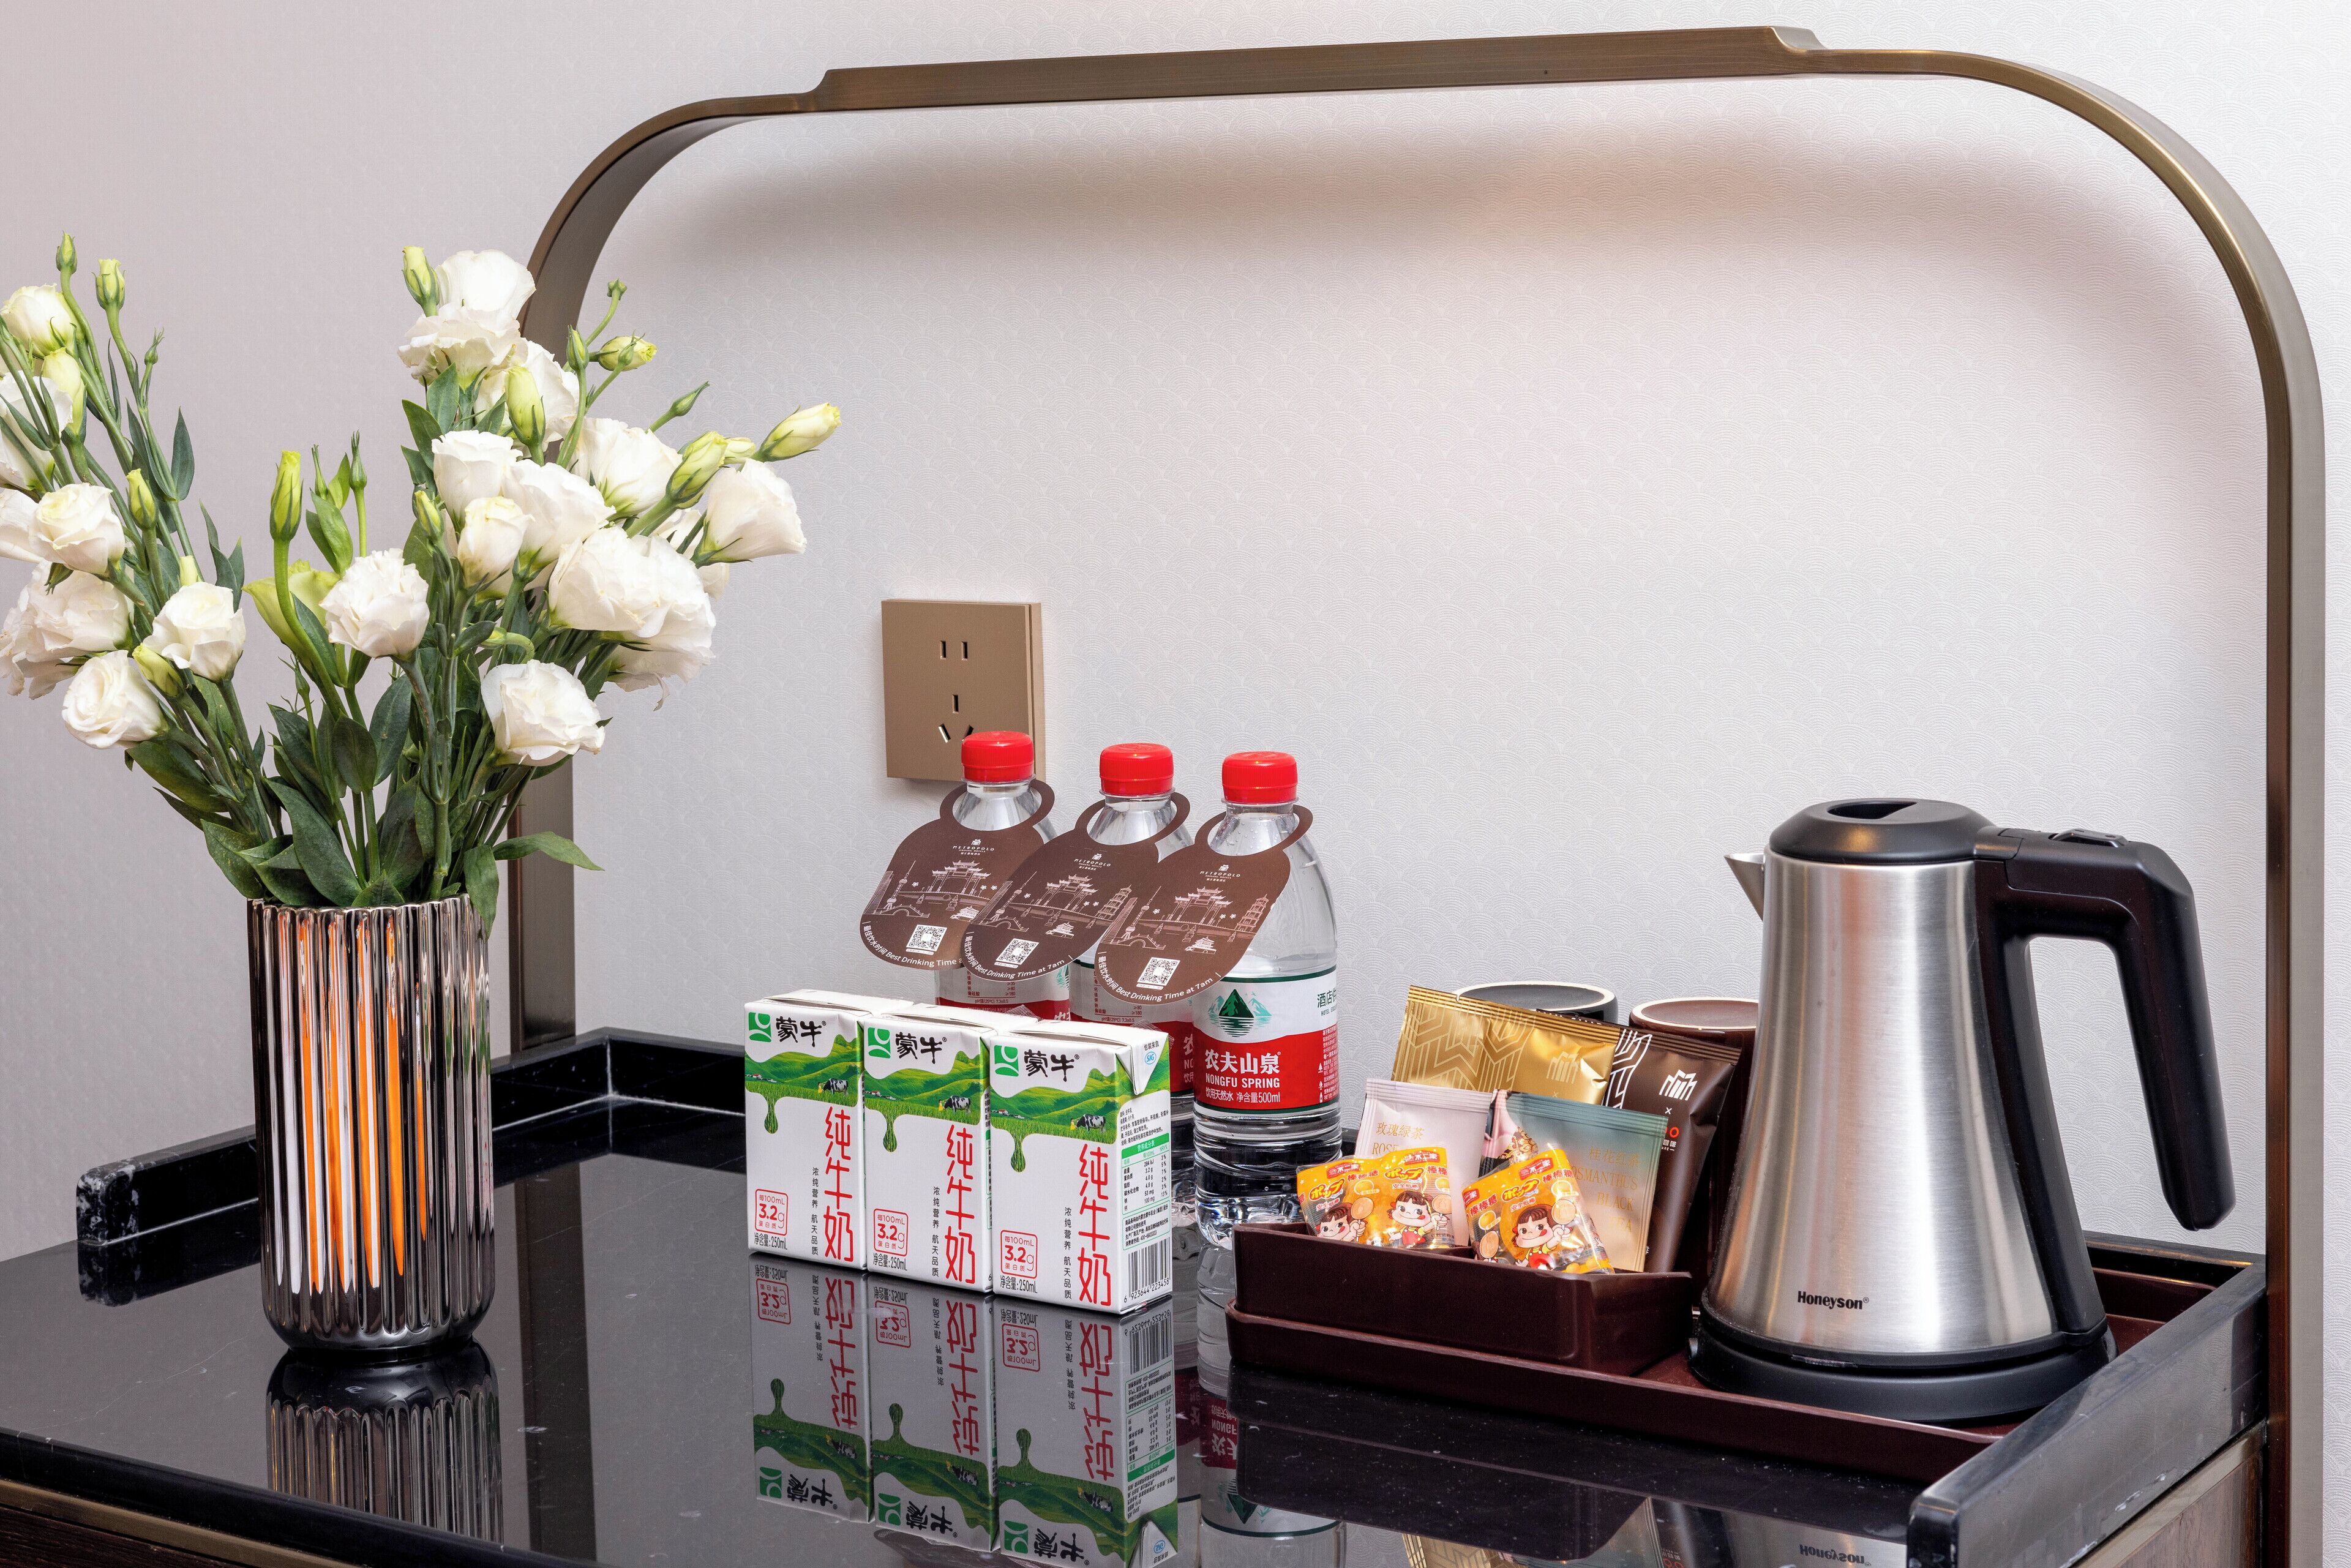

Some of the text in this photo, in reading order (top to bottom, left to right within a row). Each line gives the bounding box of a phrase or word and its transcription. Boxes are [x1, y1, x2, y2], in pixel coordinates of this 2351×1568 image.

[863, 925, 888, 955] 最佳饮水时间
[885, 951, 901, 961] Best
[901, 956, 934, 968] Drinking
[964, 936, 978, 967] 最佳饮水时间
[975, 964, 989, 974] Best
[986, 970, 1015, 980] Drinking
[1048, 959, 1065, 969] 7am
[1098, 956, 1119, 990] 最佳饮水时间
[1116, 986, 1131, 997] Best
[1130, 992, 1162, 1002] Drinking
[1164, 991, 1185, 1000] Time
[1195, 978, 1213, 989] 7am
[776, 1016, 822, 1048] 蒙牛
[895, 1032, 942, 1064] 蒙牛
[1024, 1049, 1074, 1082] 蒙牛
[1205, 1049, 1280, 1075] 农夫山泉
[1205, 1073, 1237, 1087] NONGFU
[1242, 1078, 1280, 1088] SPRING
[1205, 1087, 1280, 1103] 饮用天然水 净含量500ml
[1376, 1122, 1425, 1140] 玫瑰绿茶
[1530, 1160, 1551, 1172] 不二家
[1589, 1146, 1640, 1167] 桂花红茶
[1337, 1163, 1360, 1174] 不二家
[1386, 1168, 1423, 1179] ポップ
[1542, 1169, 1574, 1184] 棒棒糖
[823, 1106, 853, 1262] 纯牛奶
[1311, 1178, 1344, 1198] ポップ
[1504, 1180, 1539, 1201] ポップ
[759, 1195, 785, 1205] 每100mL
[945, 1124, 975, 1285] 纯牛奶
[1464, 1190, 1477, 1202] 二家
[1470, 1194, 1498, 1216] 棒棒糖
[1596, 1192, 1633, 1211] BLACK
[759, 1203, 785, 1229] 3.2g
[759, 1220, 778, 1229] 蛋白质
[877, 1214, 906, 1225] 每100mL
[1078, 1143, 1111, 1307] 纯牛奶
[1609, 1216, 1632, 1233] TEA
[811, 1214, 819, 1256] 航天品质
[877, 1223, 905, 1250] 3.2g
[1005, 1236, 1035, 1247] 每100mL
[877, 1241, 897, 1250] 蛋白质
[1005, 1245, 1034, 1272] 3.2g
[1005, 1262, 1026, 1272] 蛋白质
[1131, 1285, 1150, 1300] 923644
[1152, 1277, 1169, 1292] 223458
[1798, 1291, 1863, 1310] Honeyson
